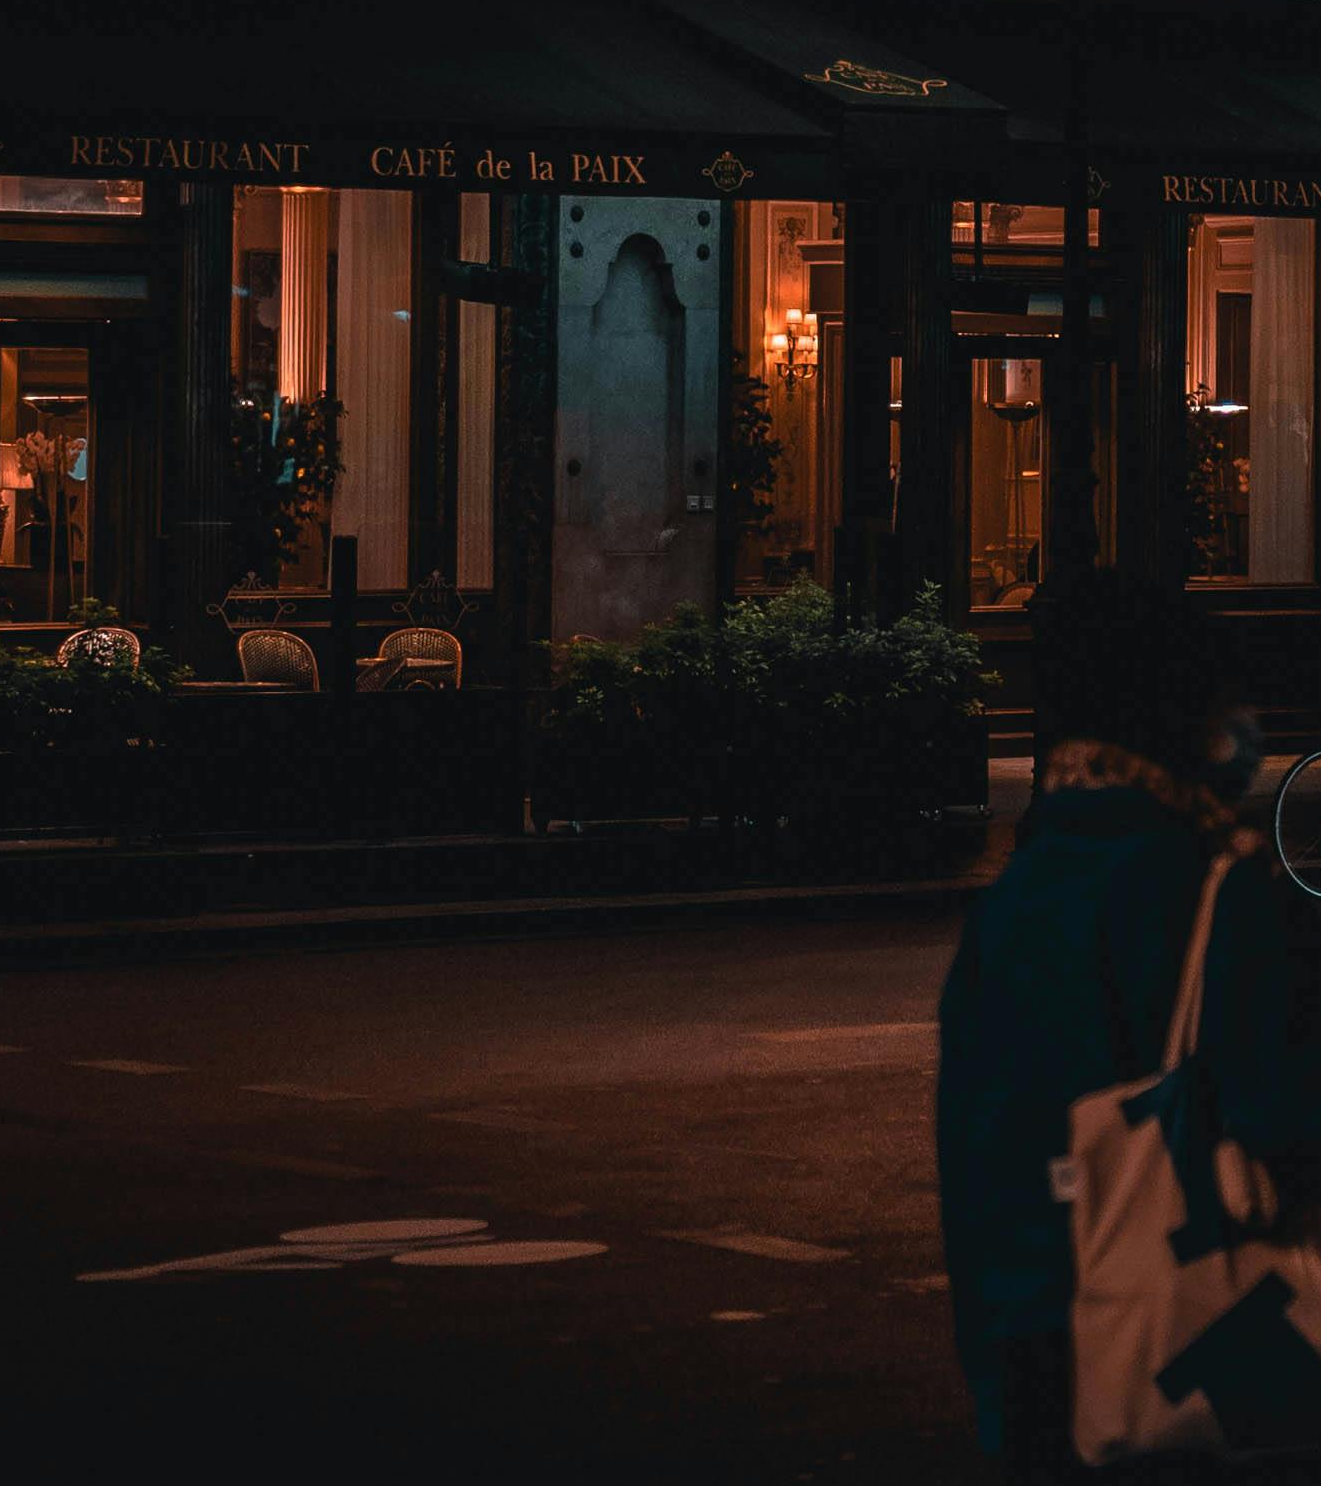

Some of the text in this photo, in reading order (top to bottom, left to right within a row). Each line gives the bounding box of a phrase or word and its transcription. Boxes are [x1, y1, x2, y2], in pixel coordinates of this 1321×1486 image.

[70, 134, 647, 185] RESTAURANT CAFÉ de la PAIX
